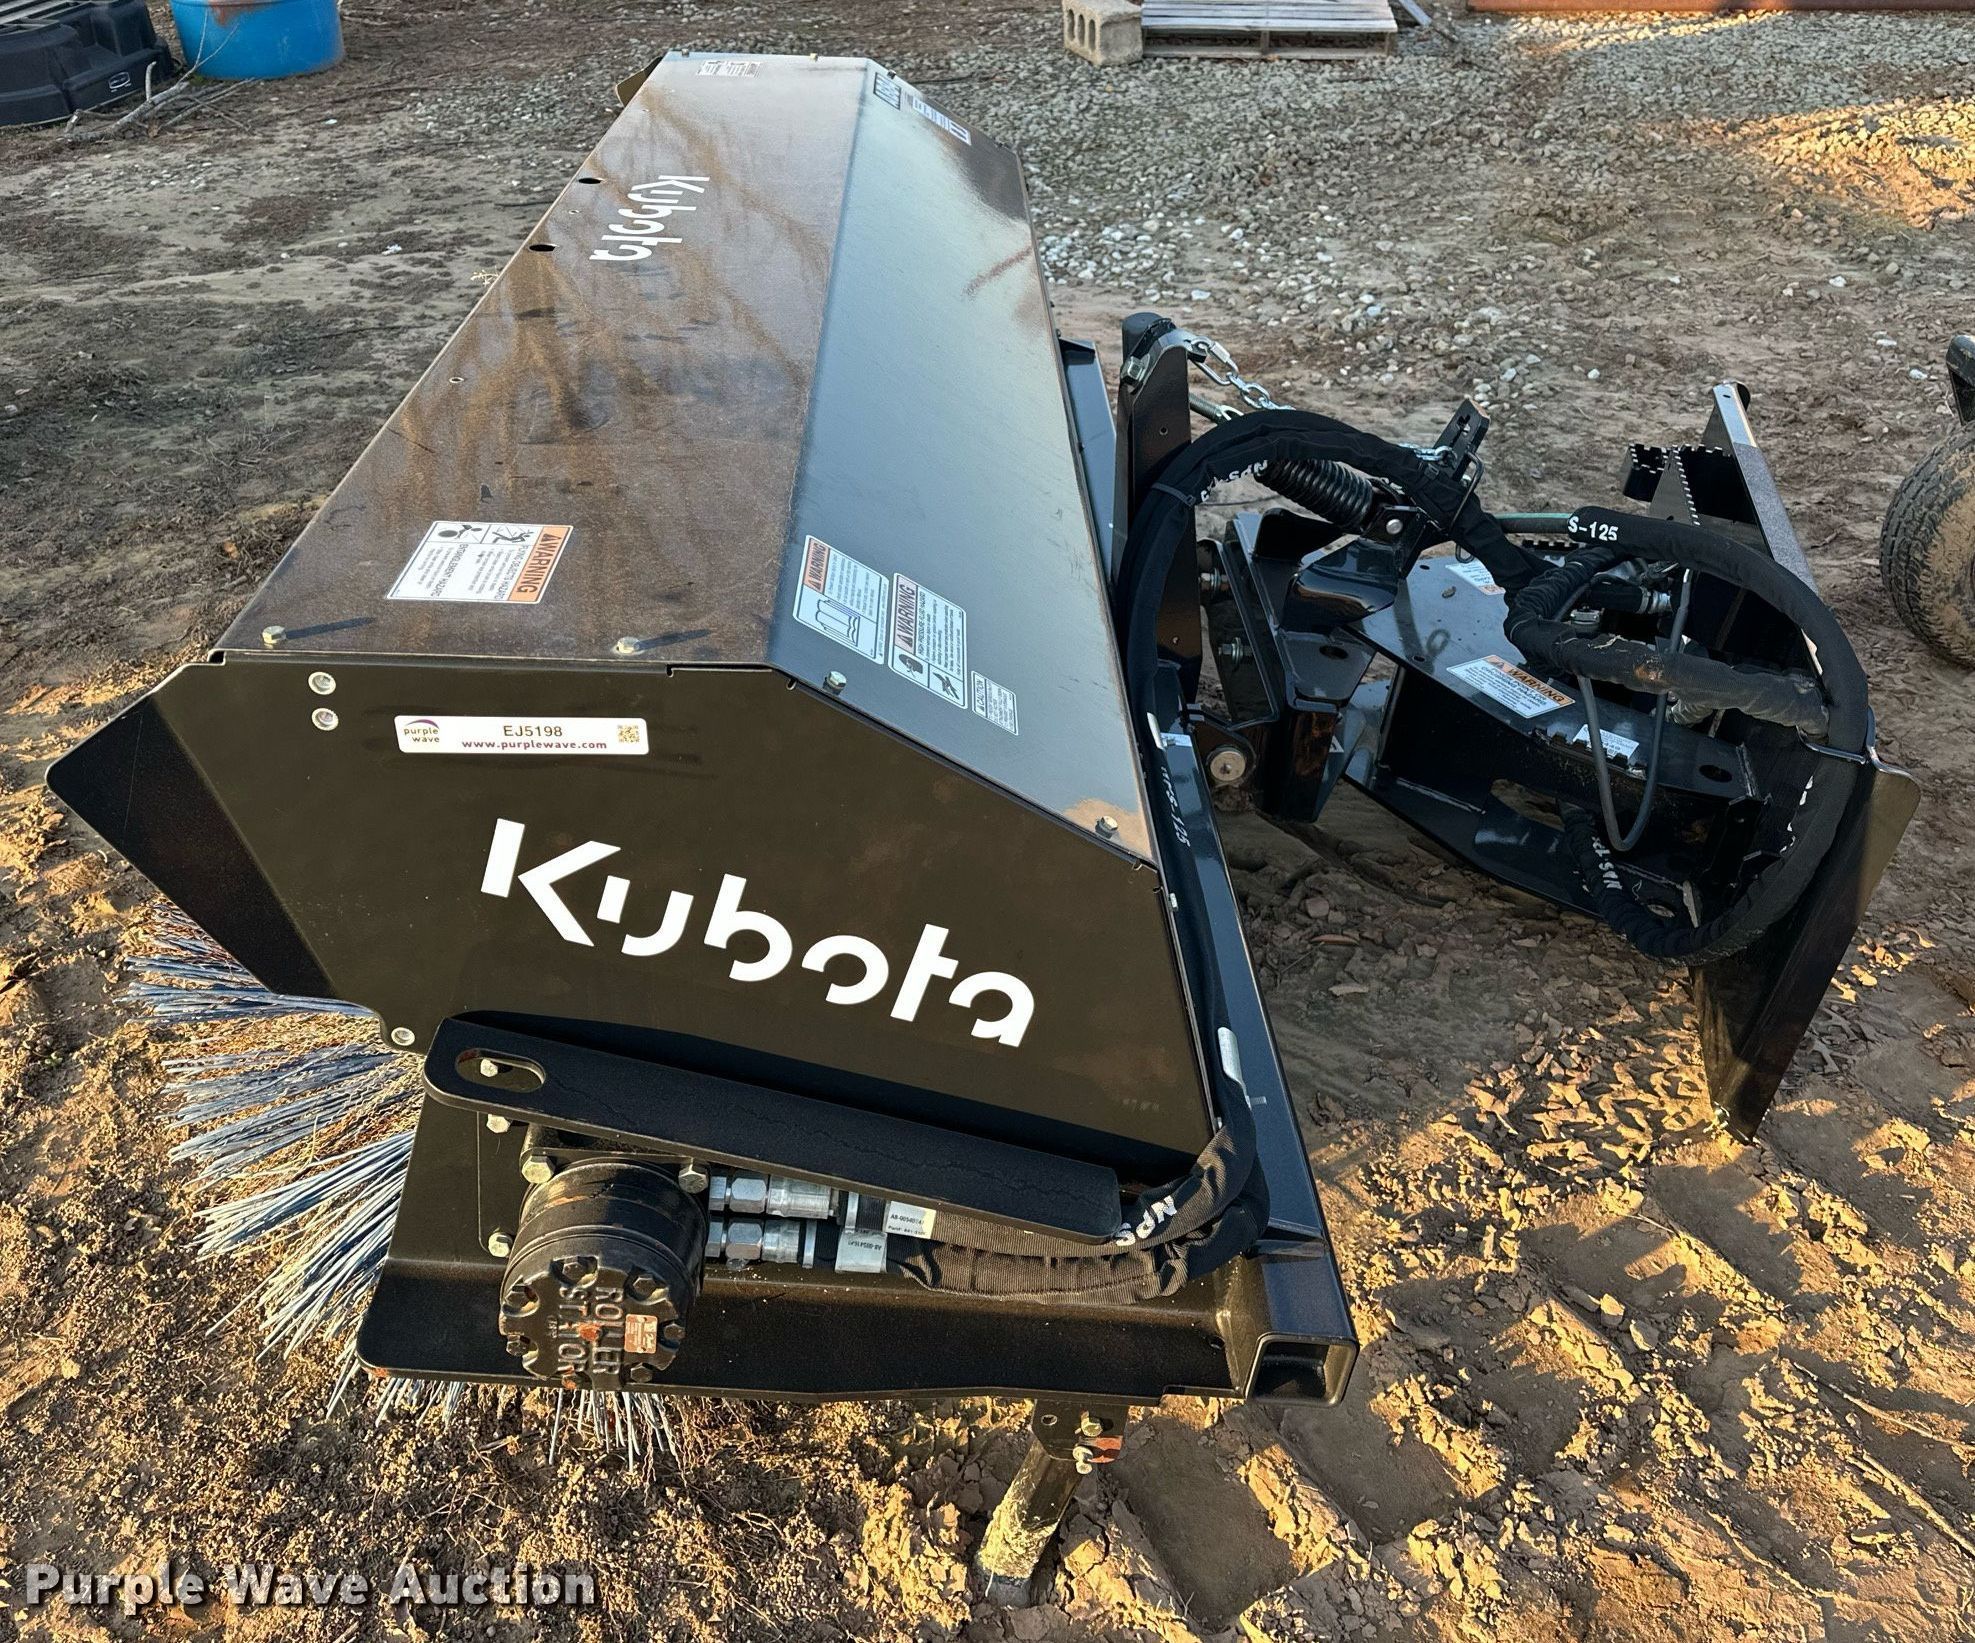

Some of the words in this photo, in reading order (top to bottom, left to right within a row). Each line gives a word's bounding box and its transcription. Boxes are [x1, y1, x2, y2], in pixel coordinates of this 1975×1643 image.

[589, 174, 710, 260] Kubota
[1567, 515, 1619, 541] S-125
[517, 541, 558, 593] WARNING
[808, 543, 826, 582] WARNING
[896, 584, 916, 636] WARNING
[1508, 668, 1565, 702] WARNING
[403, 727, 439, 736] purple
[462, 739, 607, 750] www.purplewave.com
[503, 725, 563, 737] EJ5198
[480, 817, 1036, 1048] Kubota
[592, 1286, 624, 1375] ROLLER
